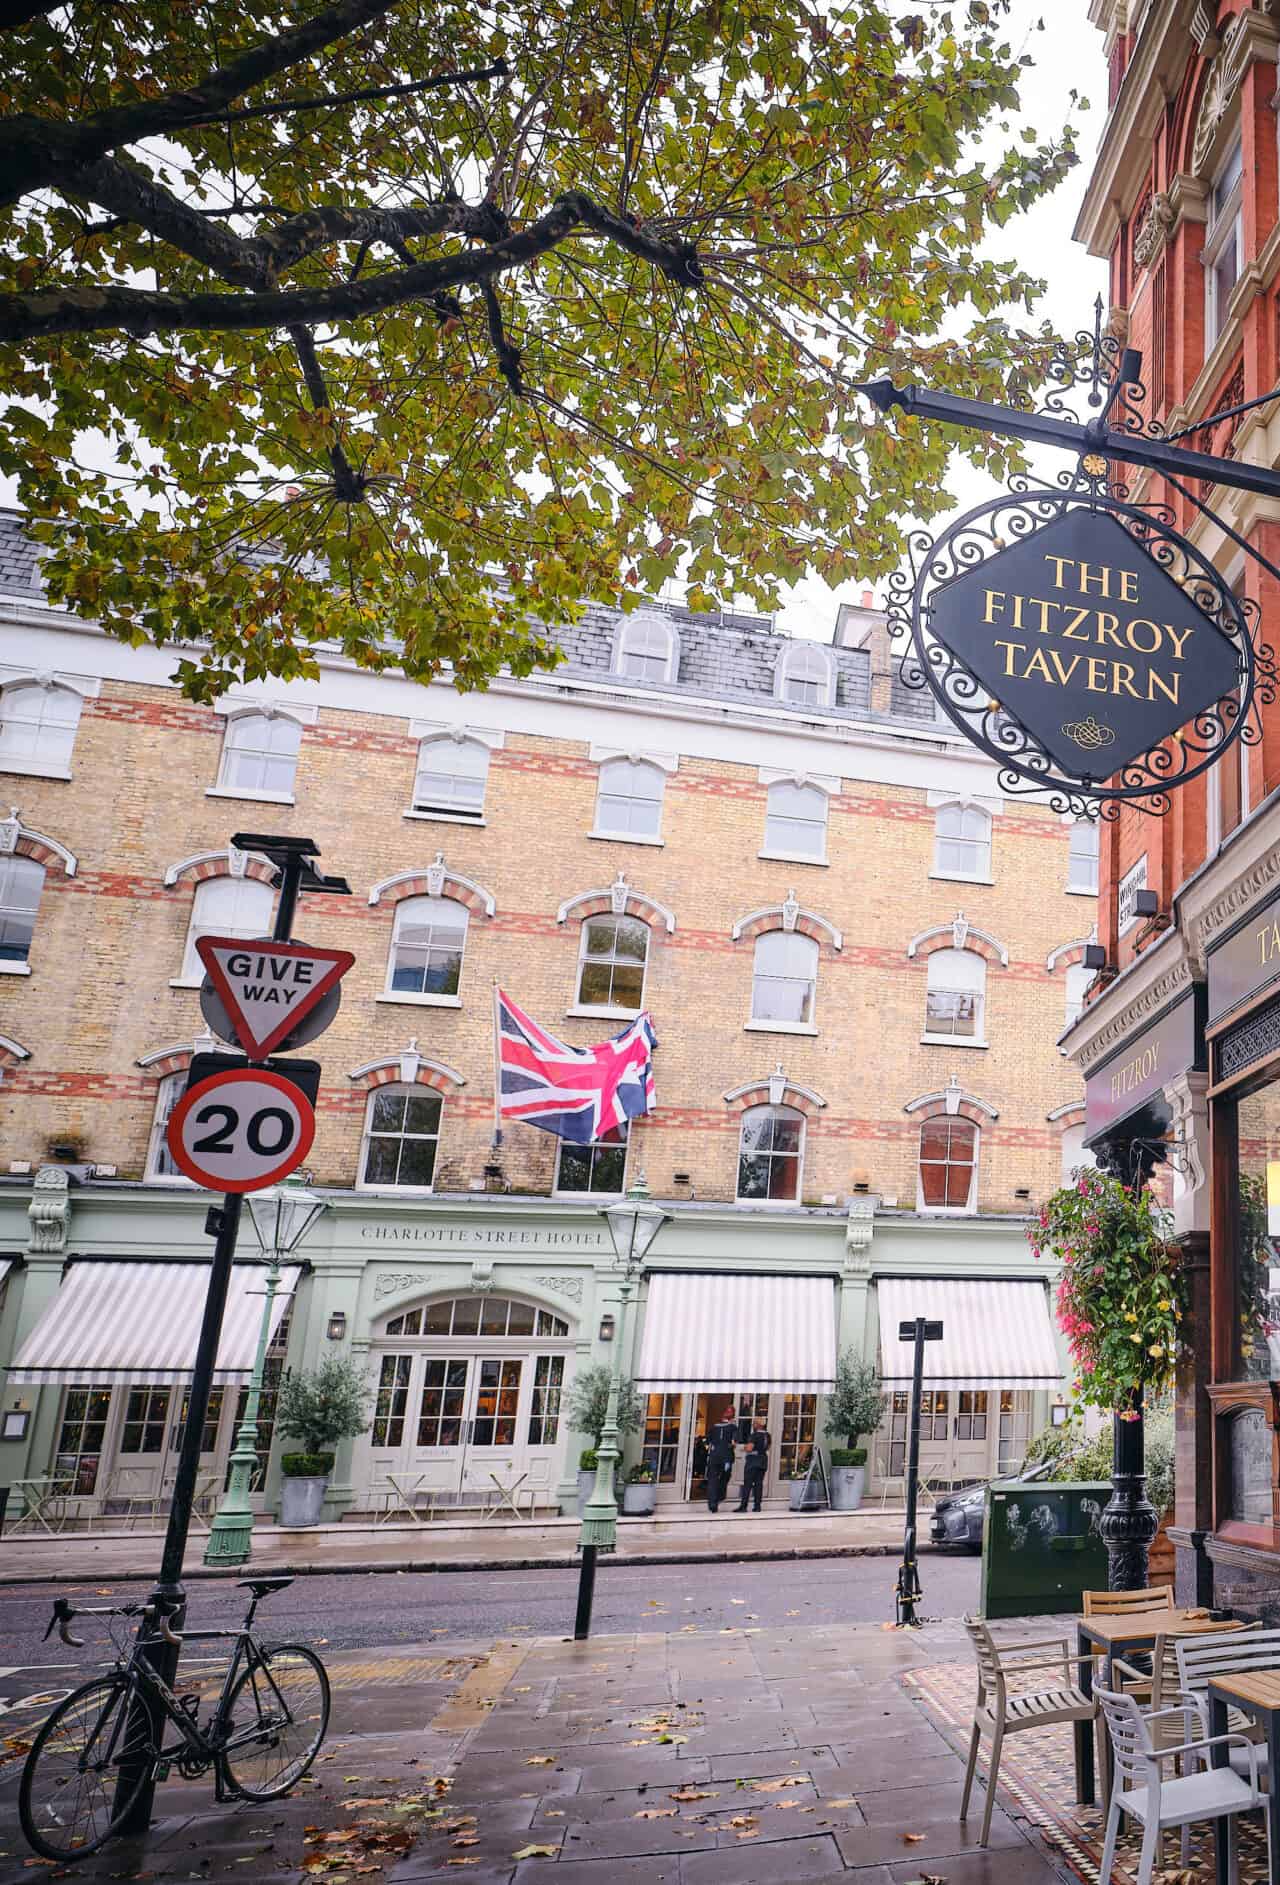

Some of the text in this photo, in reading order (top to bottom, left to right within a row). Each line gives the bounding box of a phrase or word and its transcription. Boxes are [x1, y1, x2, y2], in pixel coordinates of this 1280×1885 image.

[1044, 554, 1140, 604] THE
[980, 589, 1195, 660] FITZROY
[994, 640, 1183, 705] TAVERN
[227, 953, 314, 984] GIVE
[243, 984, 298, 1005] WAY
[1111, 1040, 1161, 1104] FITZROY
[192, 1104, 295, 1157] 20
[361, 1227, 604, 1244] CHARLOTTE STREET HOTEL
